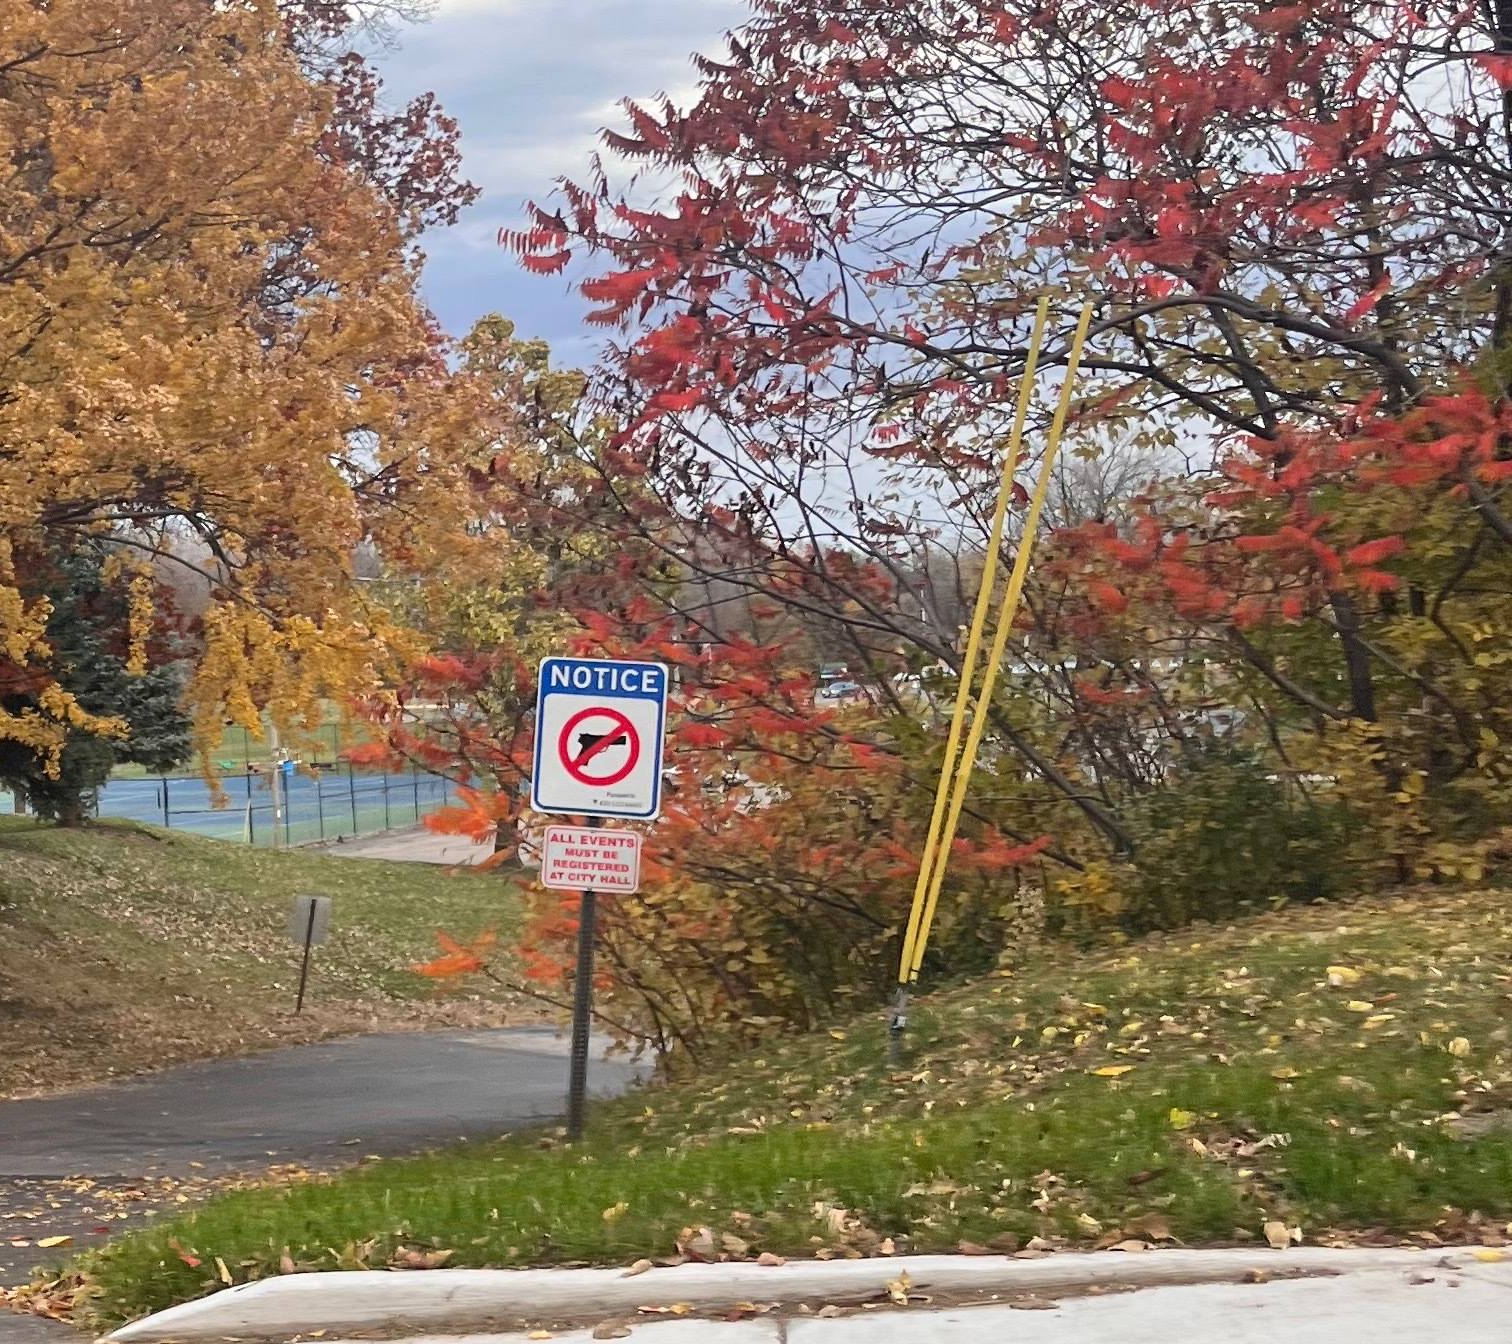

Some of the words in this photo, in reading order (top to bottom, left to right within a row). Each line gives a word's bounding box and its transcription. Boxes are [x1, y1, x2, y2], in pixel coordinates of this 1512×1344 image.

[551, 665, 659, 693] NOTICE
[550, 833, 575, 844] ALL
[580, 835, 635, 848] EVENTS
[565, 848, 598, 859] MUST
[603, 851, 618, 859] BE
[553, 859, 629, 873] REGISTERED
[550, 872, 564, 880] AT
[568, 873, 596, 882] CITY
[600, 875, 631, 885] HALL
